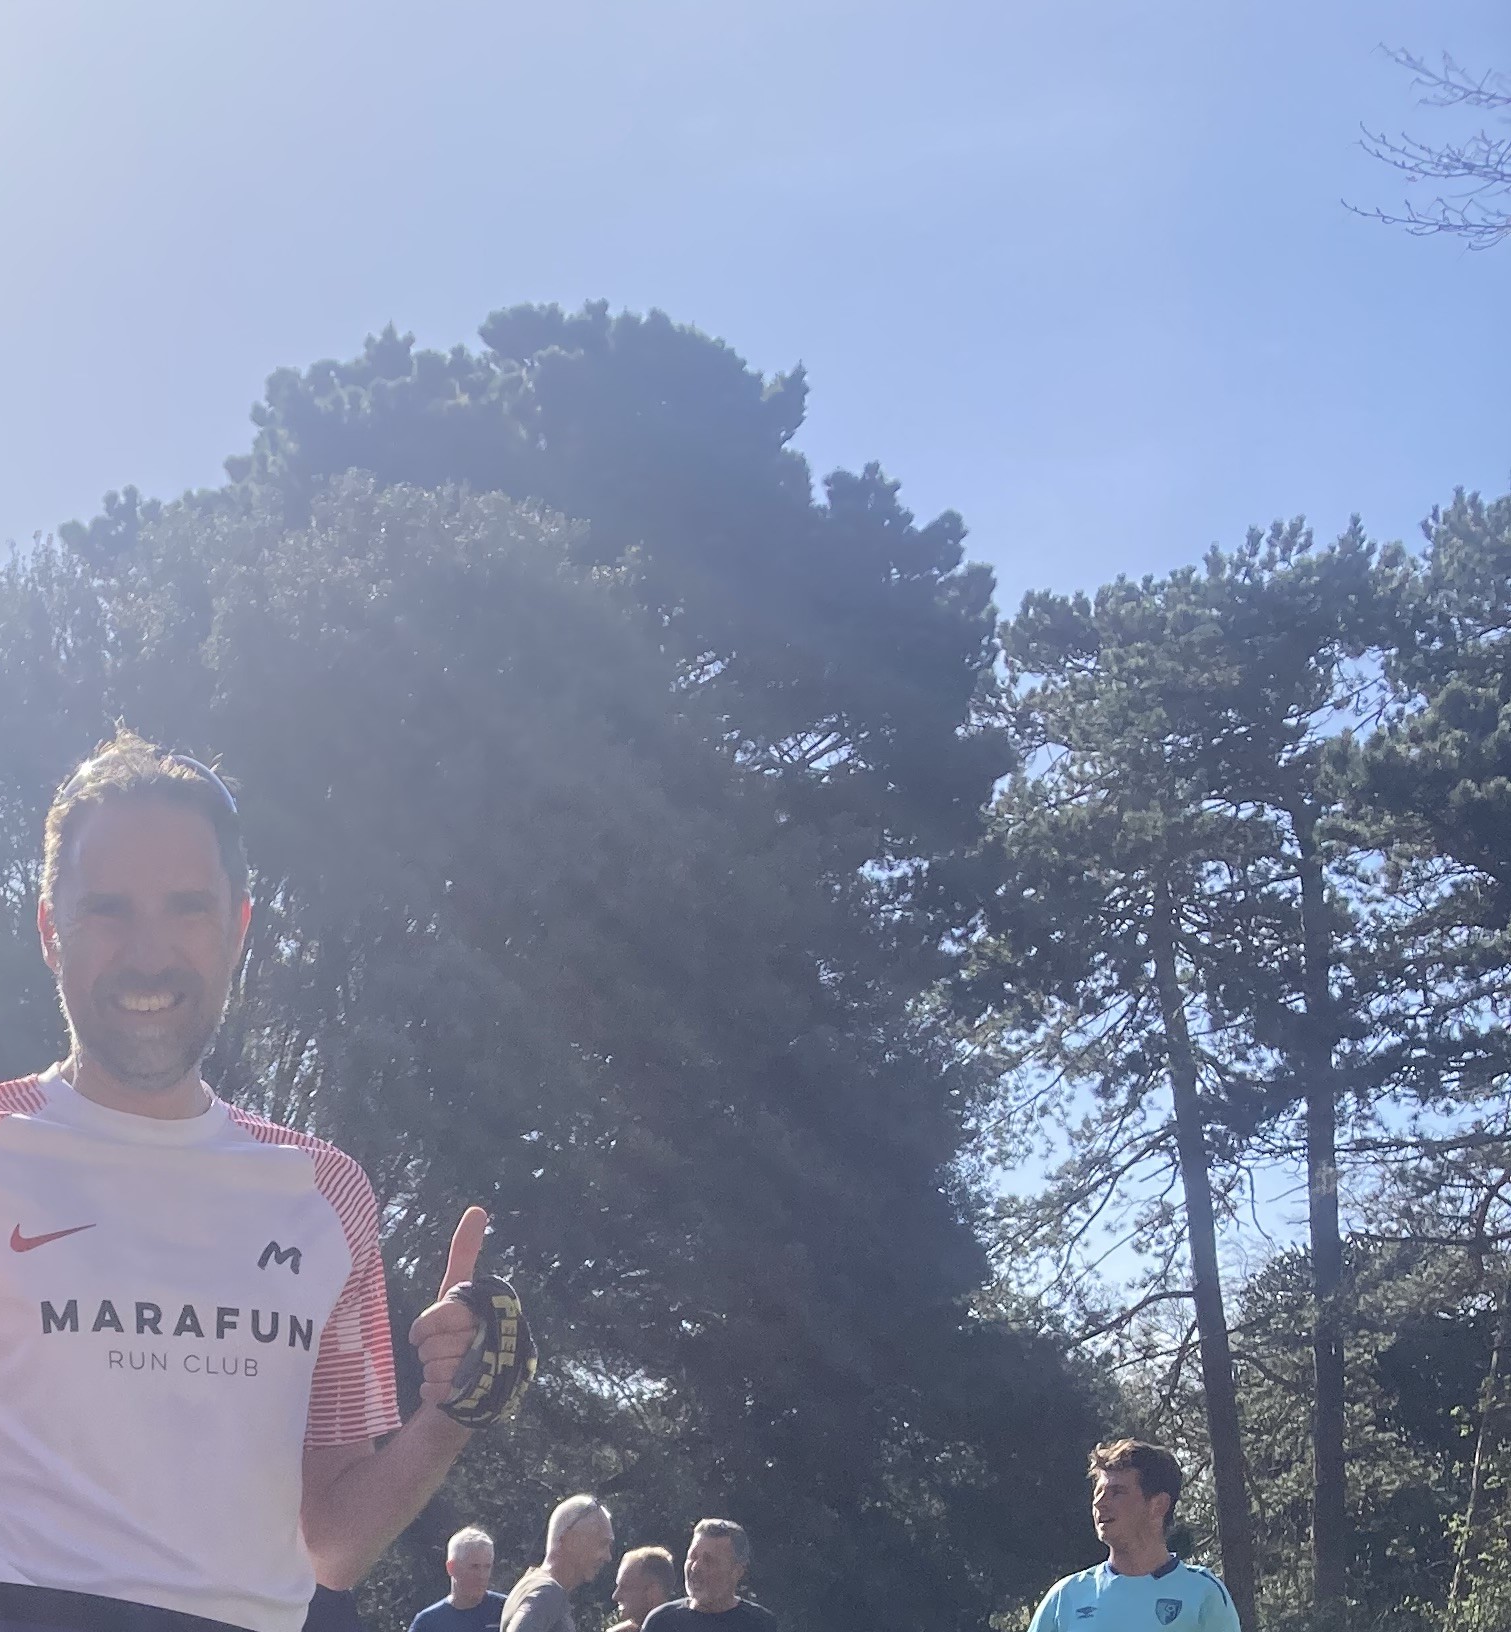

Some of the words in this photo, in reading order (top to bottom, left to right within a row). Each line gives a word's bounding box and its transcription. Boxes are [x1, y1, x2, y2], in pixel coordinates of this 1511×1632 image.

[40, 1299, 314, 1352] MARAFUN
[108, 1350, 168, 1371] RUN
[183, 1354, 259, 1377] CLUB
